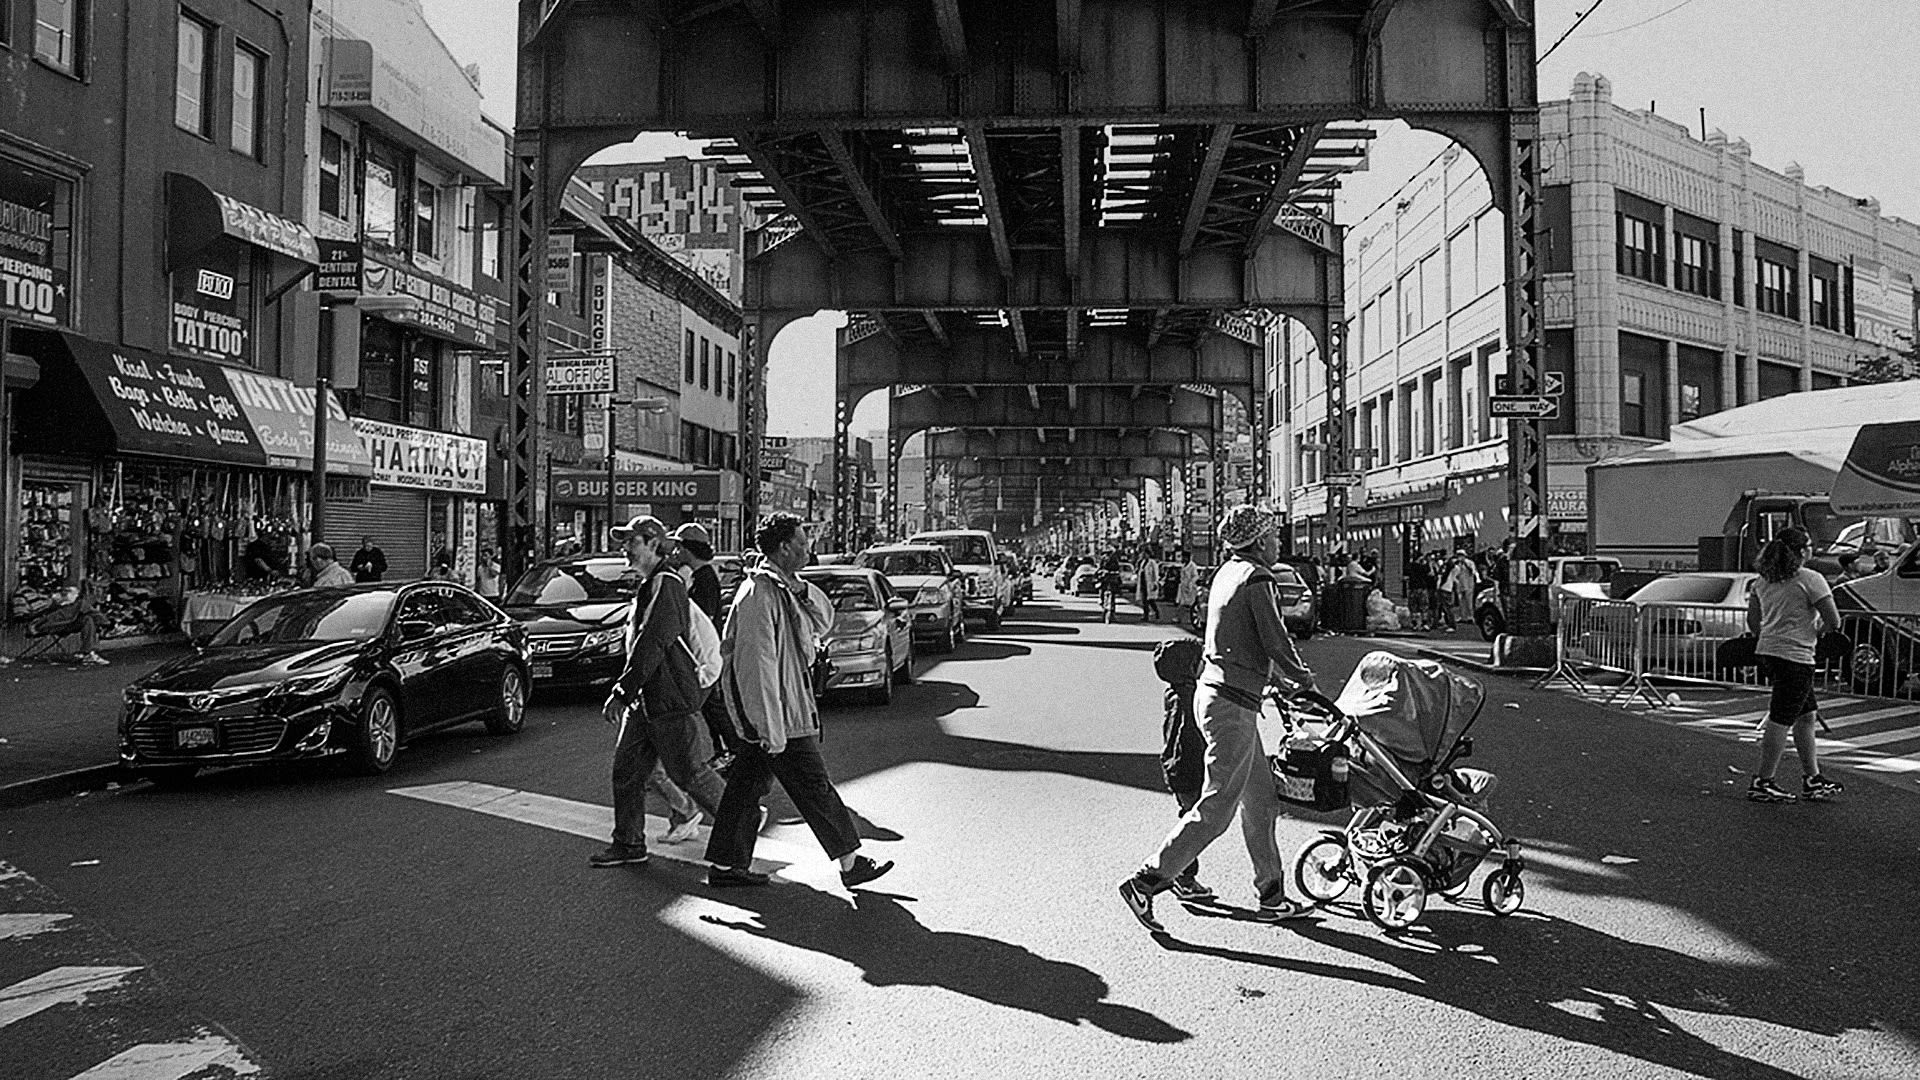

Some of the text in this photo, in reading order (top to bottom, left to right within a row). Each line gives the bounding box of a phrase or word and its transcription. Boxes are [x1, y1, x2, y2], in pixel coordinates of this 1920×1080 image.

[319, 262, 358, 273] CENTURY
[318, 276, 358, 287] DENTAL
[174, 302, 242, 330] BODY PIERCING
[174, 315, 242, 356] TATTOO
[565, 366, 610, 383] OFFICE
[108, 375, 150, 407] Bags
[1495, 402, 1550, 411] ONE WAY
[130, 406, 192, 436] Watches
[577, 481, 698, 496] BURGER KING
